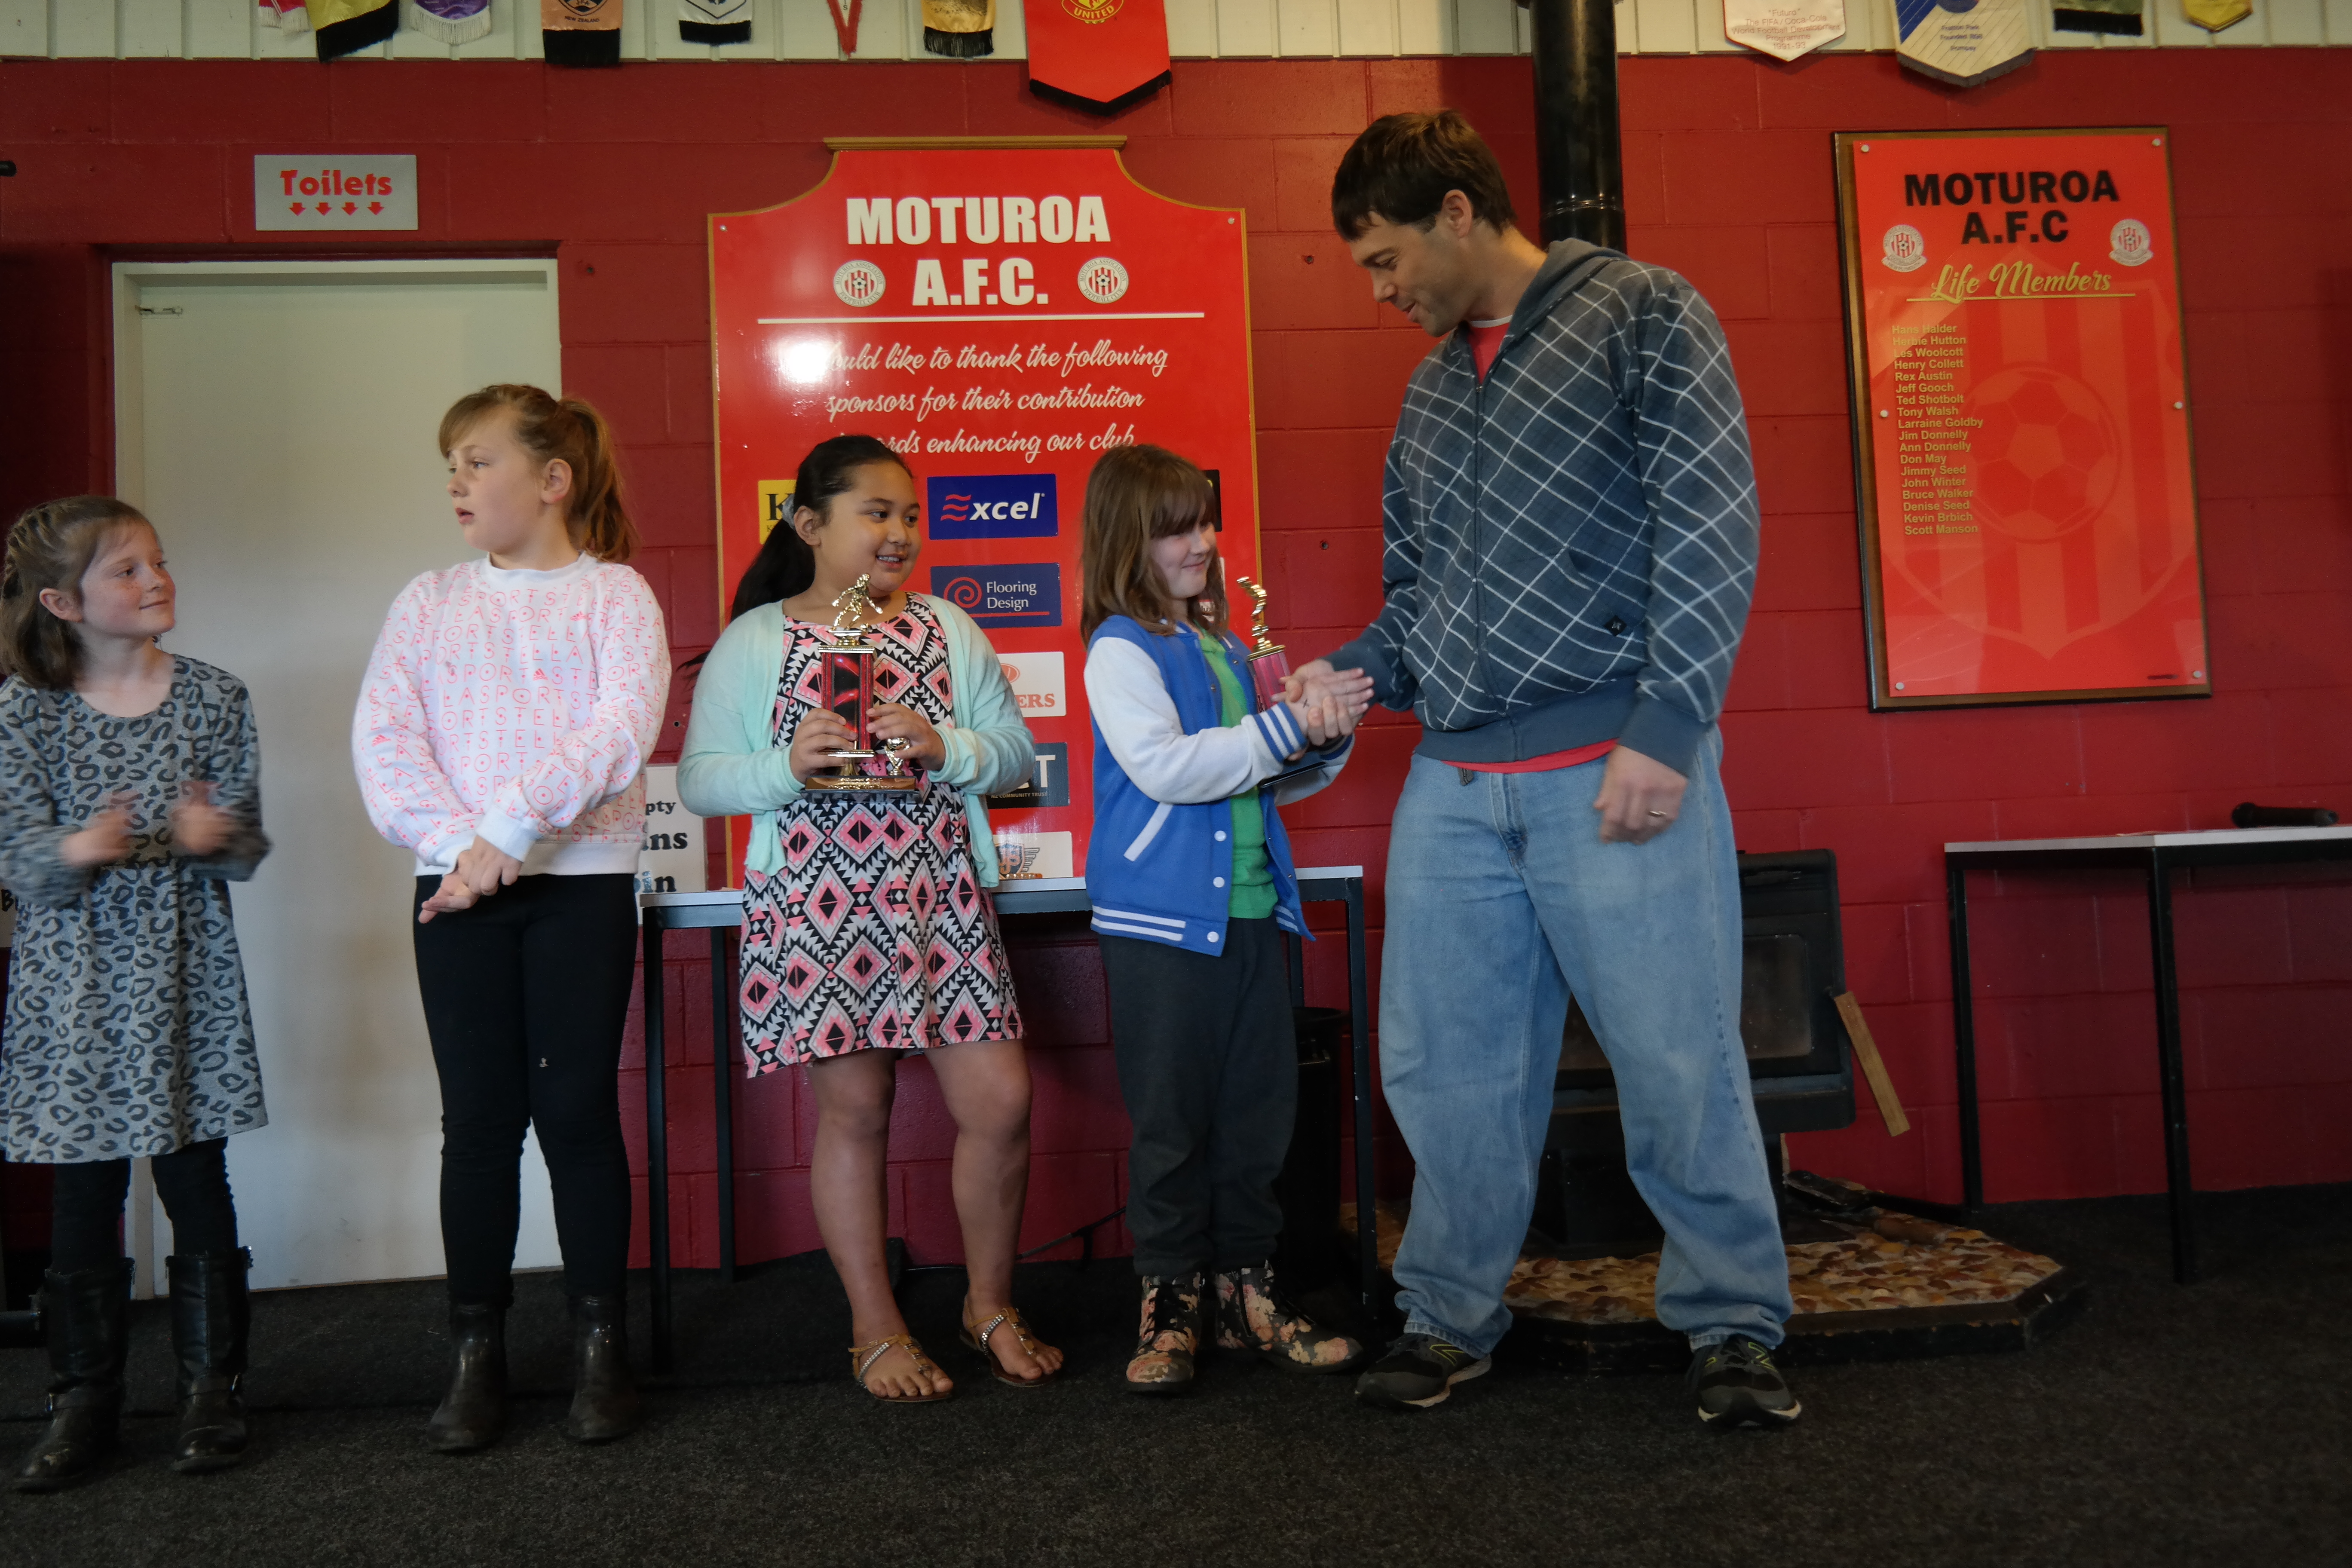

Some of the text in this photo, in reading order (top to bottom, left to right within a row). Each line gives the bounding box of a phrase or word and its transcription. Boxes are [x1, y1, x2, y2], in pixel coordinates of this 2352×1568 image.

[1074, 5, 1115, 19] UNITED
[1785, 15, 1827, 24] Coca-Cola
[1758, 26, 1787, 34] Football
[280, 169, 393, 196] Toilets
[1904, 170, 2119, 207] MOTUROA
[846, 196, 1111, 245] MOTUROA
[1961, 210, 2069, 245] A.F.C
[912, 257, 1049, 306] A.F.C.
[1930, 261, 2112, 304] Life Members
[1892, 325, 1919, 334] Hans
[1893, 336, 1966, 346] Herbie Hutton
[824, 339, 1168, 377] ould like to thank the following
[1894, 347, 1963, 358] Les Woolcott
[1894, 359, 1964, 371] Henry Collett
[1895, 371, 1953, 381] Rex Austin
[1896, 383, 1954, 393] Jeff Gooch
[825, 383, 1145, 423] sponsors for their contribution
[1896, 394, 1964, 404] Ted Shotbolt
[1897, 406, 1959, 418] Tony Walsh
[1898, 418, 1983, 429] Larraine Goldby
[1899, 430, 1968, 441] Jim Donnelly
[927, 428, 1042, 464] enhancing
[1046, 432, 1085, 452] our
[1899, 441, 1971, 452] Ann Donnelly
[1900, 454, 1947, 465] Don May
[1901, 465, 1966, 477] Jimmy Seed
[1902, 478, 1966, 488] John Winter
[1902, 489, 1974, 499] Bruce Walker
[940, 492, 1041, 522] Excel
[1903, 501, 1970, 511] Denise Seed
[1904, 514, 1934, 523] Kevin
[1905, 525, 1978, 536] Scott Manson
[986, 581, 1037, 596] Flooring
[987, 597, 1029, 612] Design
[642, 832, 688, 851] ns
